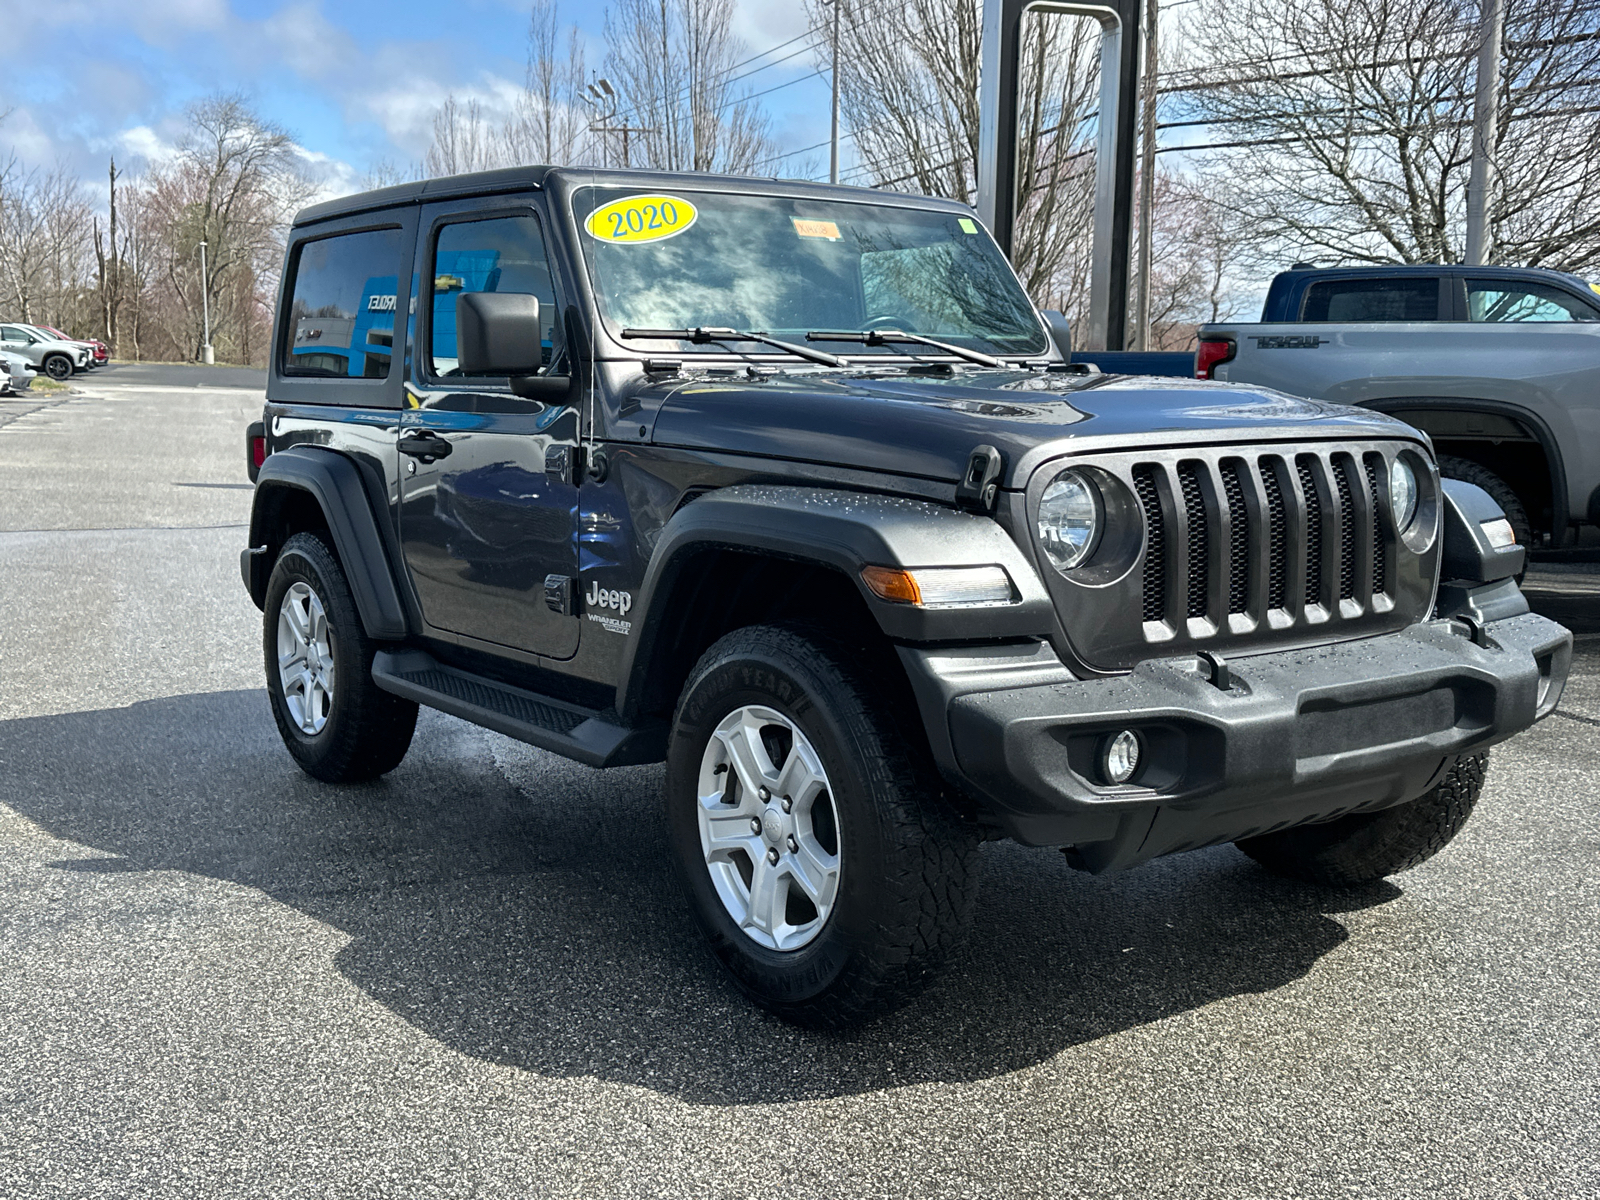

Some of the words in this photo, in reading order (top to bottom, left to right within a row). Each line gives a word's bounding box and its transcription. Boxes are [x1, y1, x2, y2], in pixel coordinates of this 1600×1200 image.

[608, 202, 678, 238] 2020
[586, 581, 632, 615] Jeep
[587, 612, 632, 628] WRANGLER
